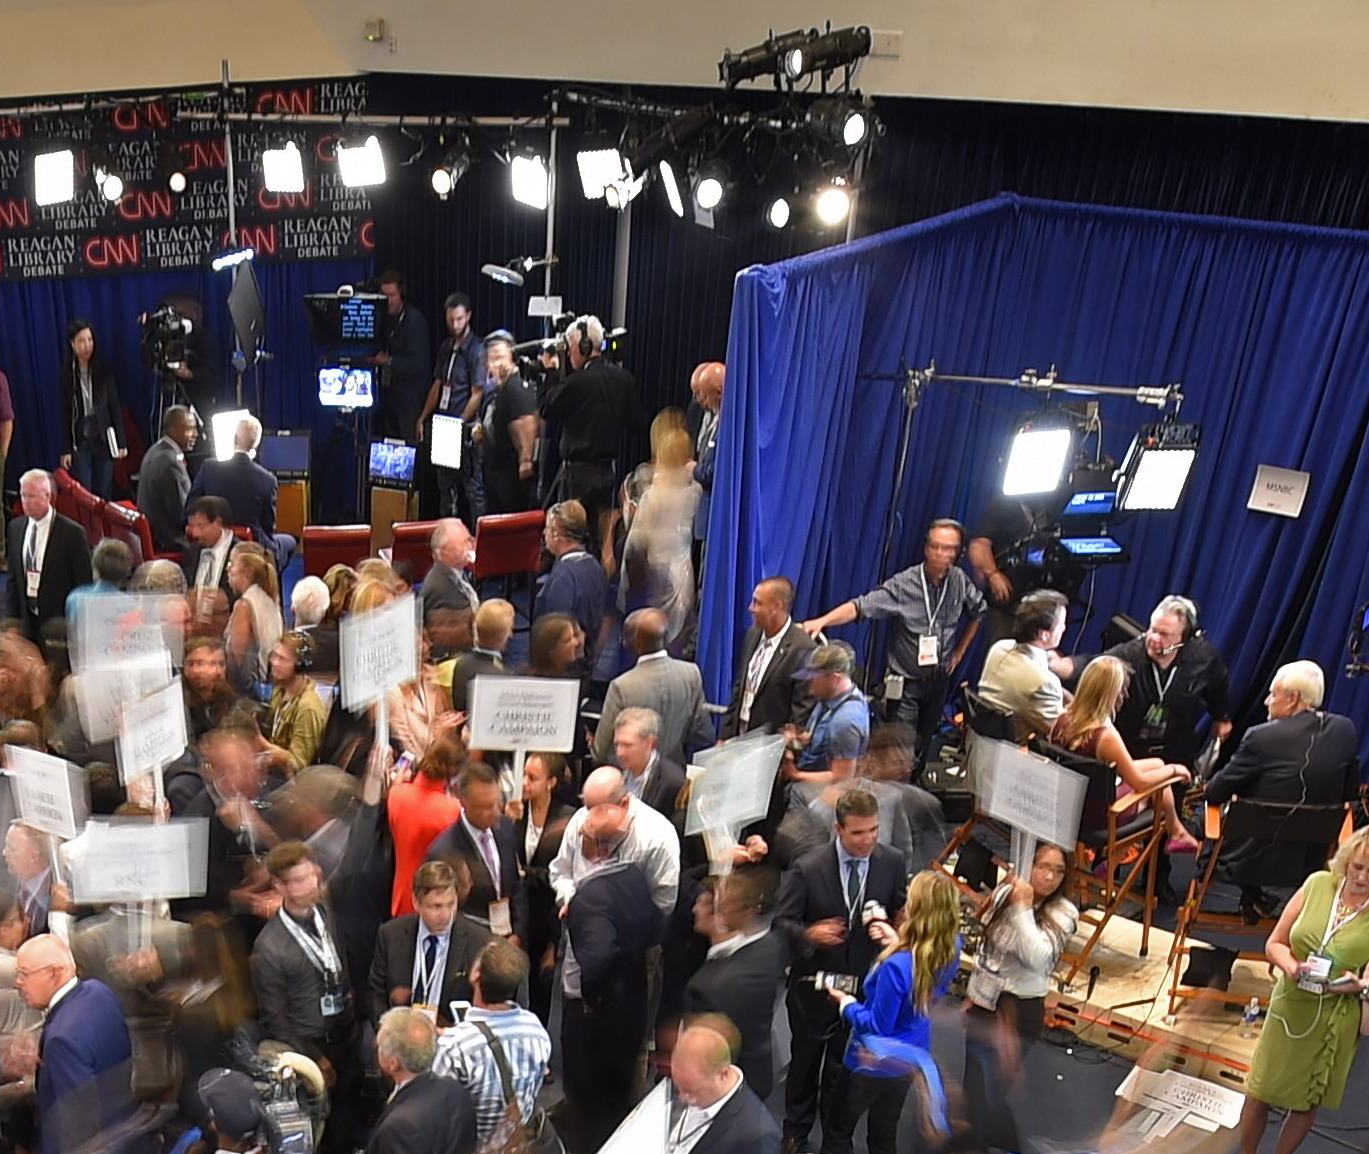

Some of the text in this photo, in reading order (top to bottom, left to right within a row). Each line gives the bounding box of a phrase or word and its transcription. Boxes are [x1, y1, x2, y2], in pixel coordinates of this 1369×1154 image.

[284, 217, 352, 233] REAGAN
[145, 225, 213, 243] REAGAN
[285, 232, 352, 248] LIBRARY
[8, 235, 75, 252] REAGAN
[85, 228, 141, 268] CNN
[147, 240, 214, 257] LIBRARY
[9, 250, 75, 267] LIBRARY
[1265, 481, 1295, 496] MSNBC
[491, 723, 557, 736] CAMPAIGN
